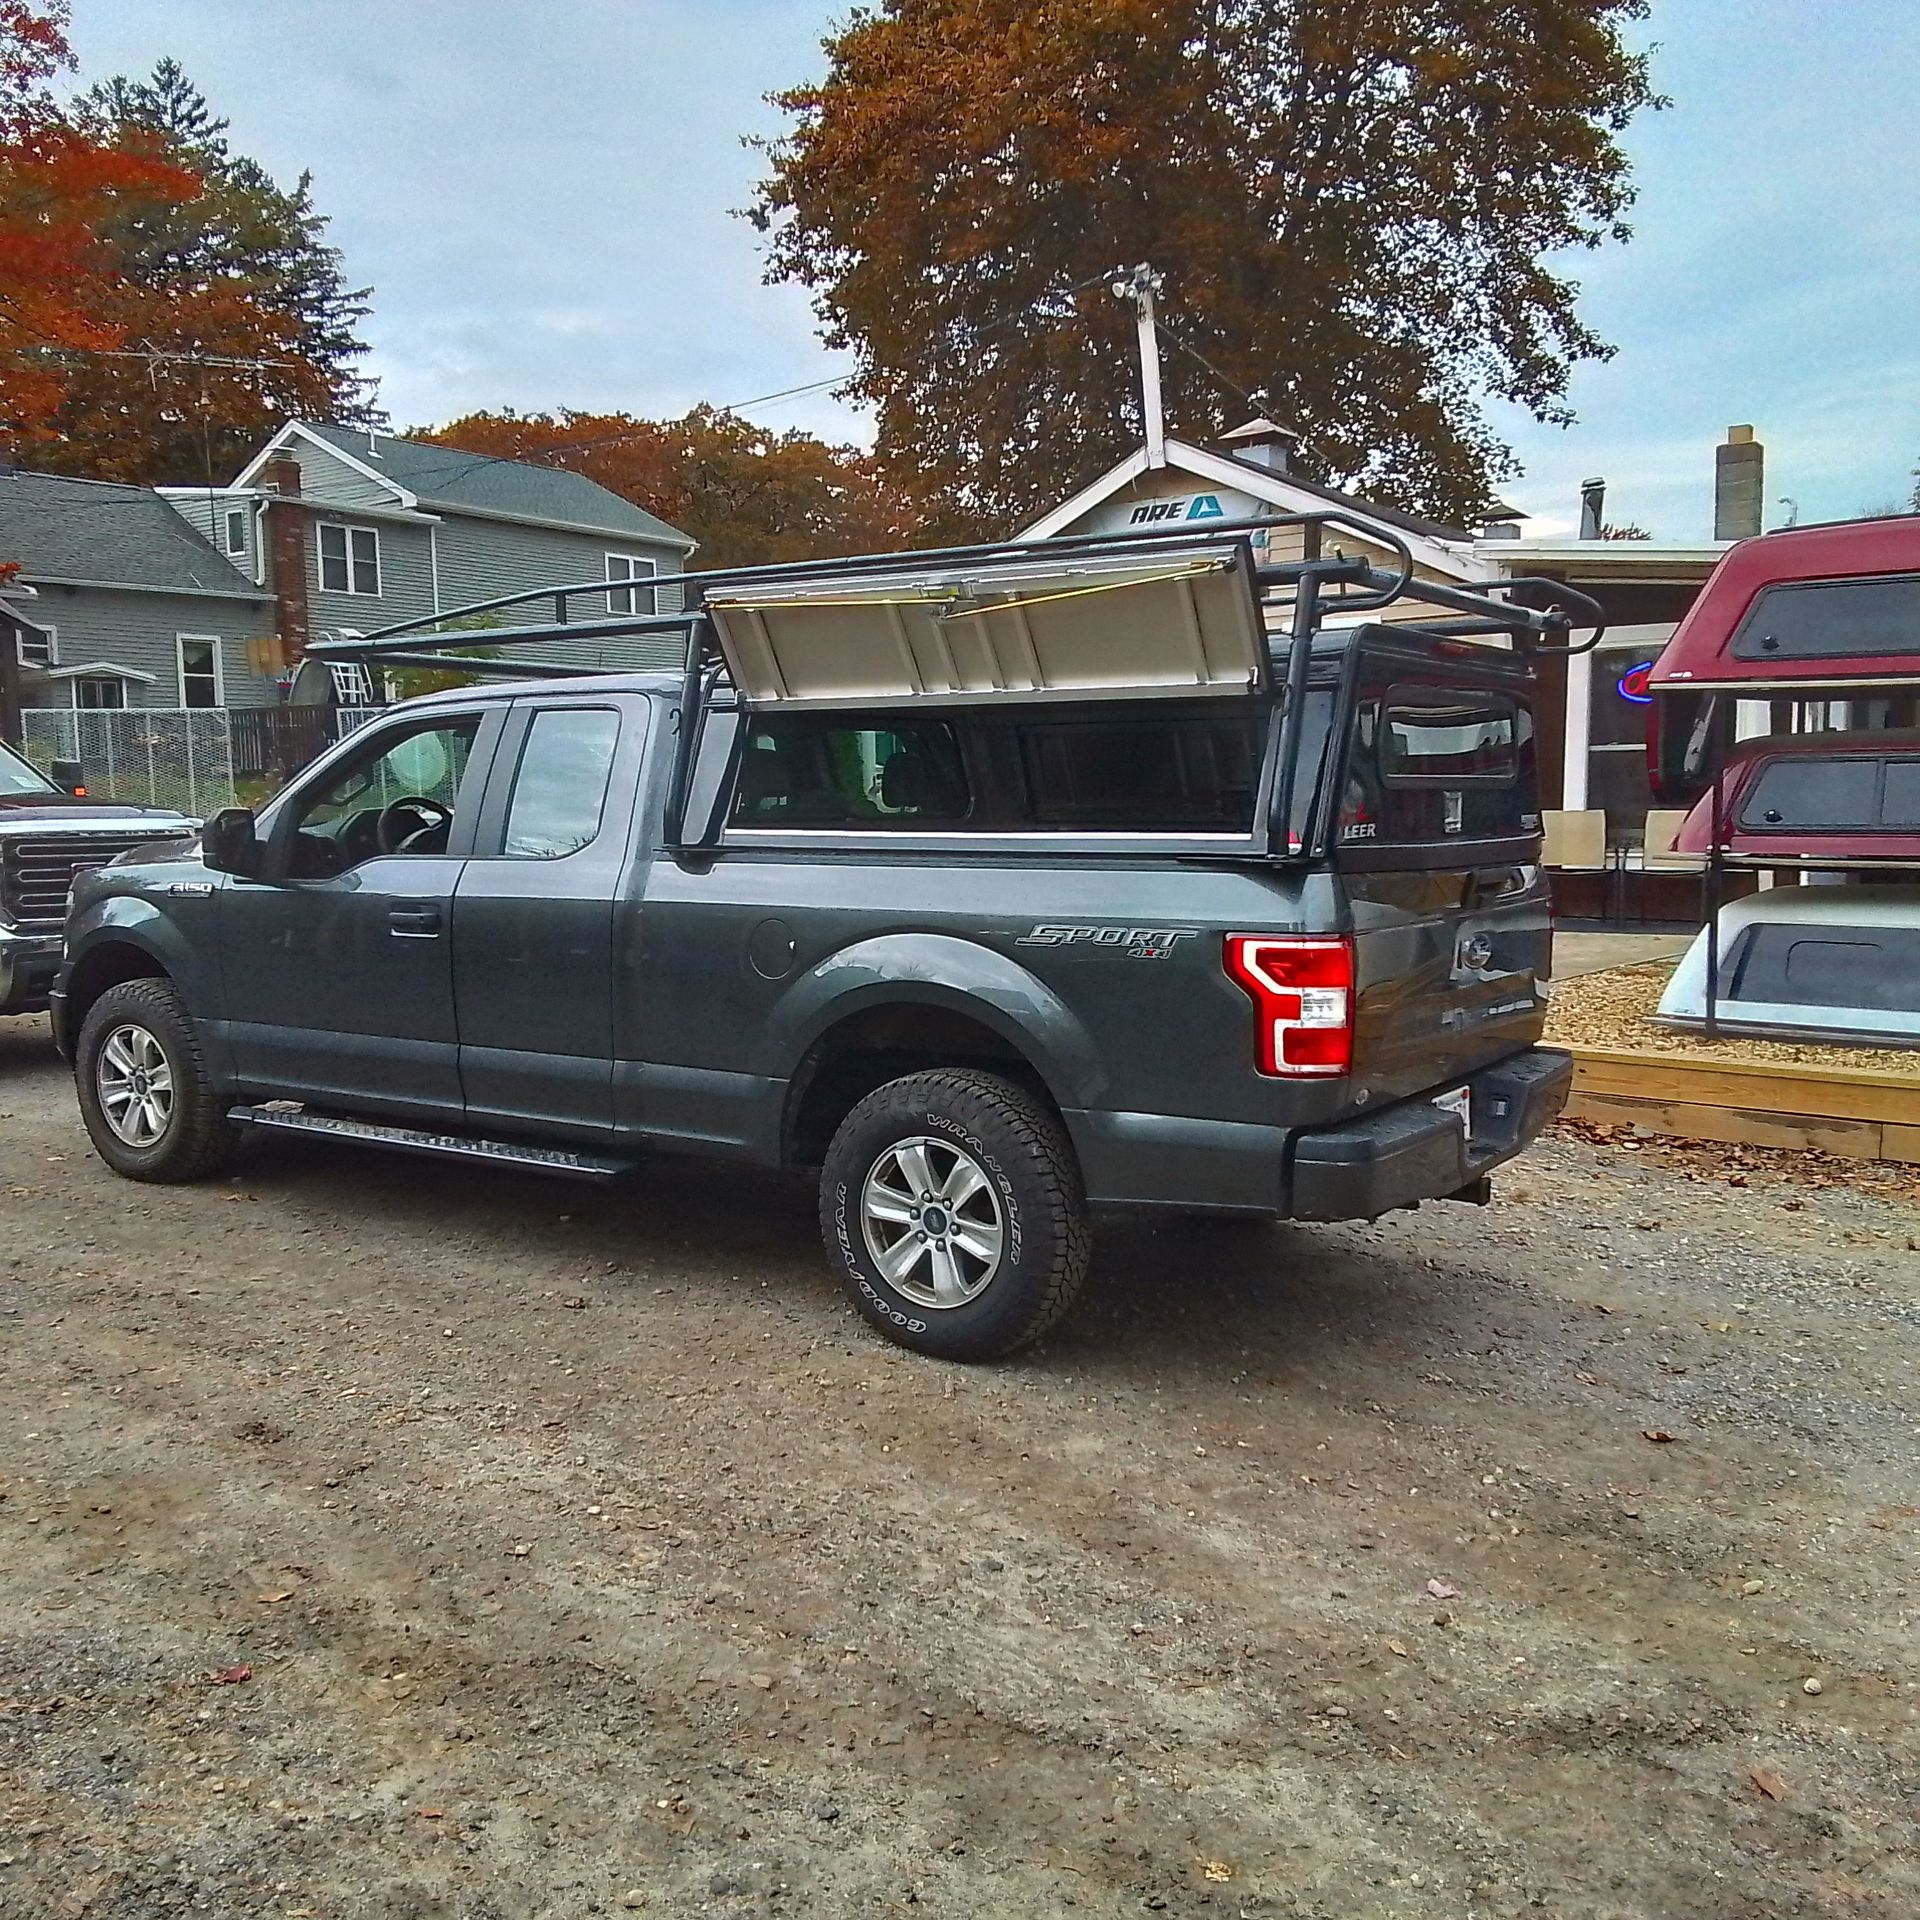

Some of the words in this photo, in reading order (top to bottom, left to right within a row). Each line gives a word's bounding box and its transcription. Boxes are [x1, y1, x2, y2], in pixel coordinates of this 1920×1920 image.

[1129, 501, 1186, 525] ARE
[1343, 823, 1376, 839] LEER
[1014, 924, 1199, 947] SPORT
[927, 1113, 1022, 1265] WRANGLER
[835, 1183, 927, 1333] GOODYEAR
